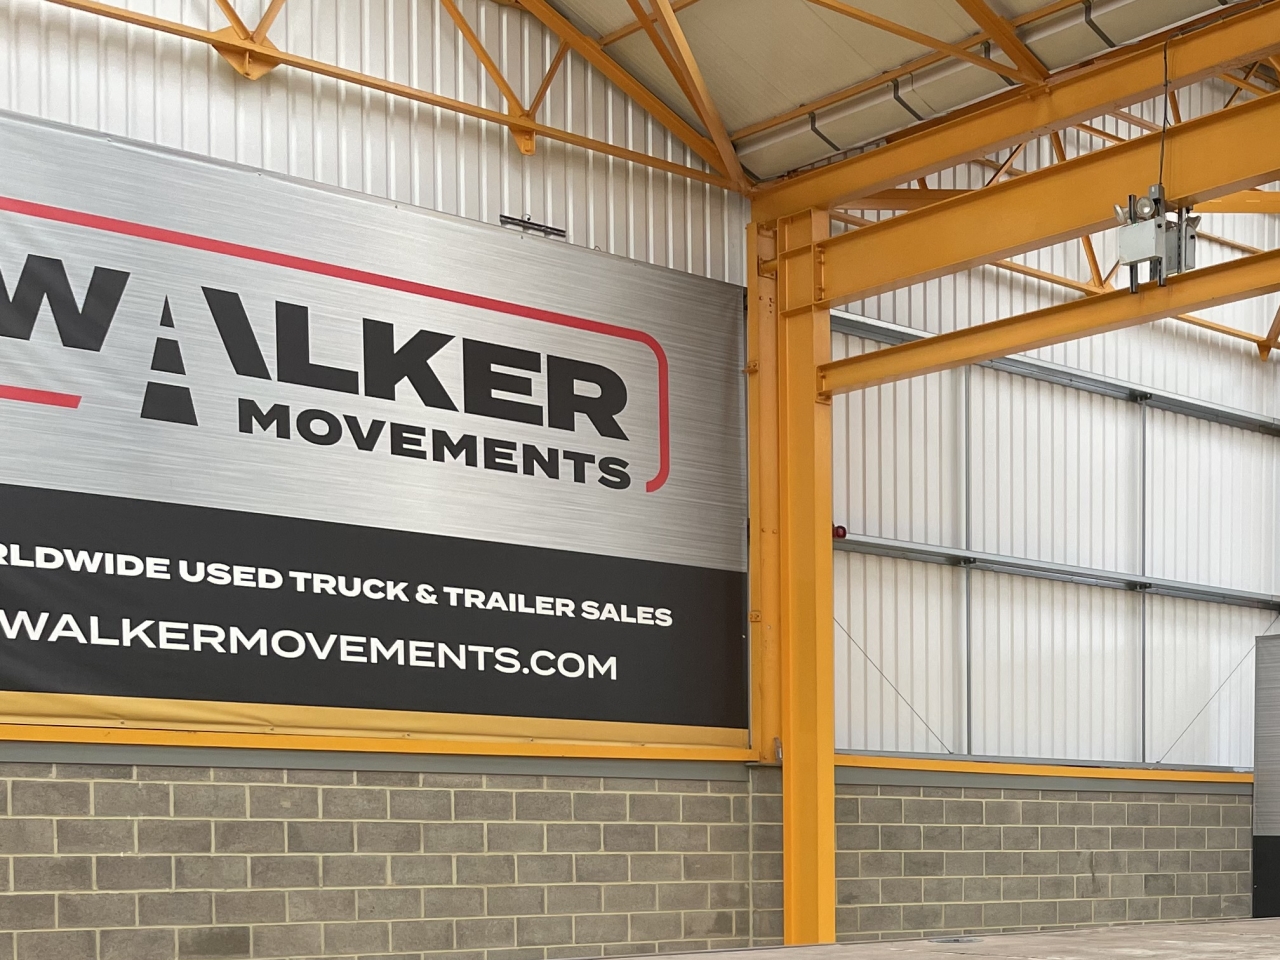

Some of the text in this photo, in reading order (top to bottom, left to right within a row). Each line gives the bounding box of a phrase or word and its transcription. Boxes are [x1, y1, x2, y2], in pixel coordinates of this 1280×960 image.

[237, 397, 631, 490] MOVEMENTS
[178, 560, 284, 590] USED
[288, 570, 410, 602] TRUCK
[415, 583, 439, 605] &
[442, 586, 576, 618] TRAILER
[581, 600, 673, 627] SALES
[0, 608, 617, 681] WALKERMOVEMENTS.COM
